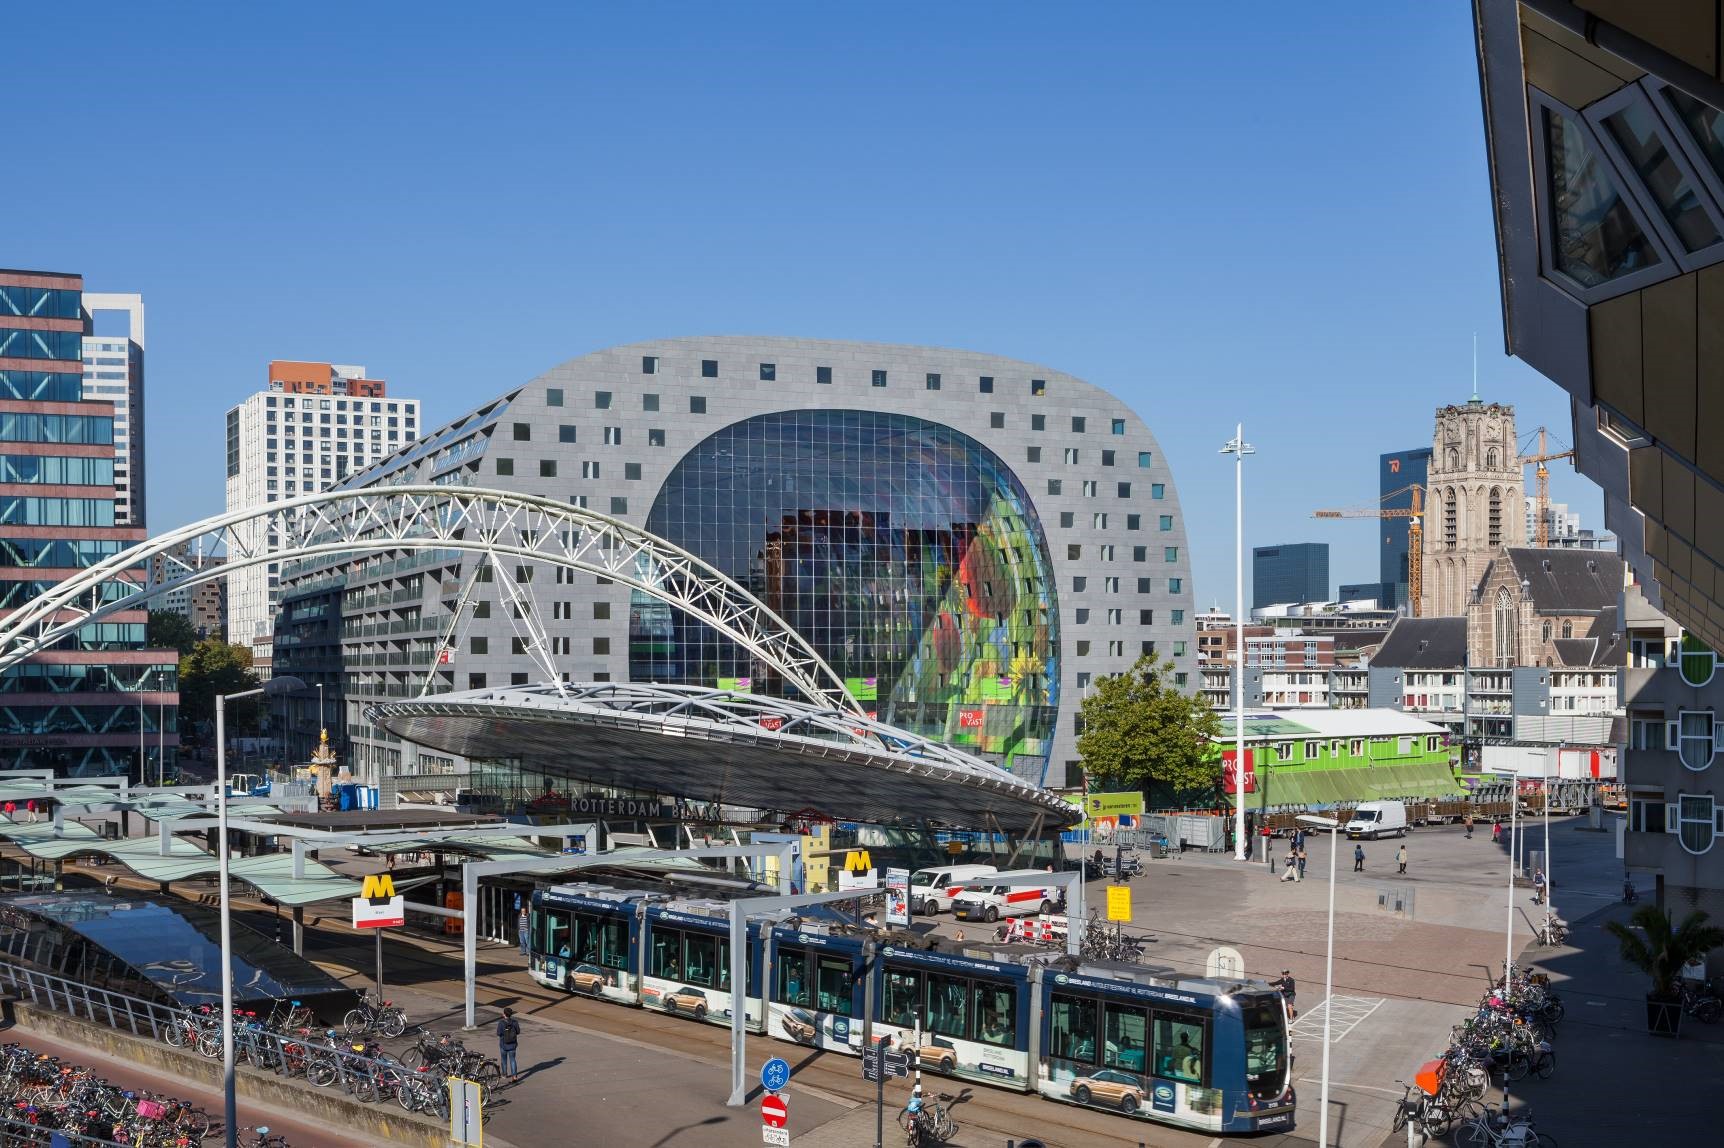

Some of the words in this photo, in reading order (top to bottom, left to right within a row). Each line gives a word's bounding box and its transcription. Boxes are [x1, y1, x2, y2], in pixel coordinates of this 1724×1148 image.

[967, 718, 983, 727] VAST
[1232, 771, 1254, 785] VST
[570, 799, 660, 817] ROTTERDAM
[671, 802, 721, 821] BLAAK
